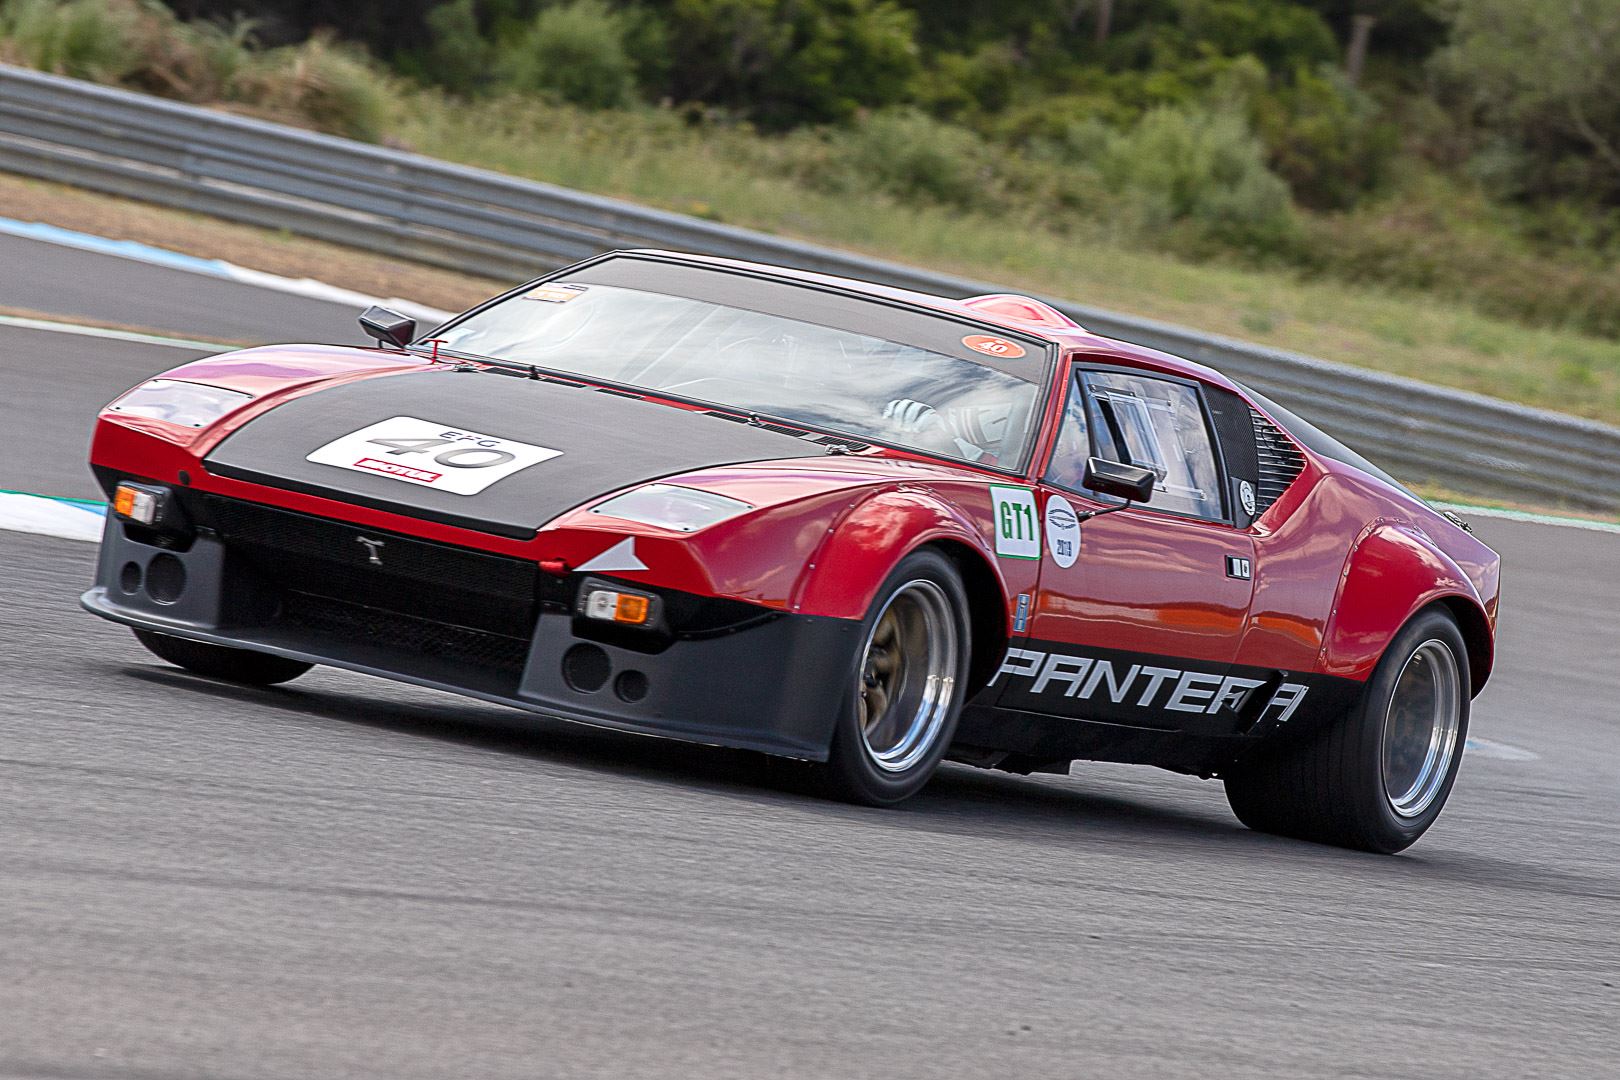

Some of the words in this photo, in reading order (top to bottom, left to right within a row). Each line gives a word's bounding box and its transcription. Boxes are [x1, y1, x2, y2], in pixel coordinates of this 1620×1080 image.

[978, 341, 1009, 354] 40
[365, 438, 516, 469] 40
[1001, 501, 1034, 541] GT1
